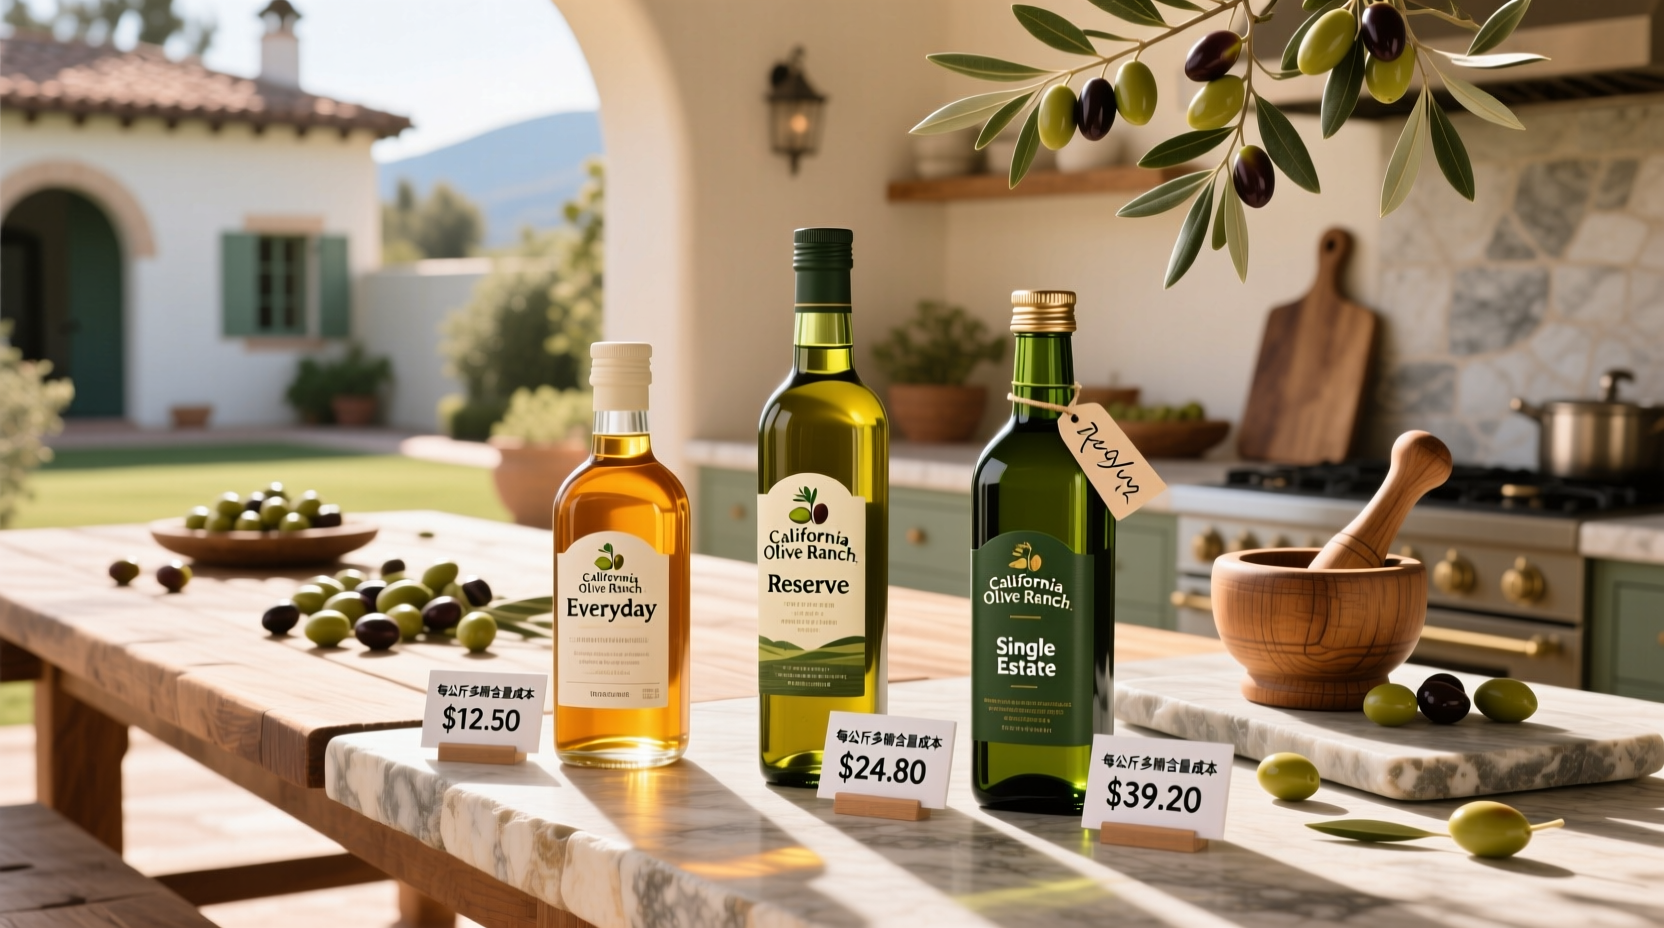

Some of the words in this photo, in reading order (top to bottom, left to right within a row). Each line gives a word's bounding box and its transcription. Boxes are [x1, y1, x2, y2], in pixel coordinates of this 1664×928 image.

[769, 527, 849, 547] California
[763, 544, 803, 560] Olive
[578, 583, 606, 593] Olive
[767, 573, 850, 595] Reserve
[989, 573, 1063, 594] California
[983, 590, 1021, 605] Olive
[566, 597, 658, 623] Everyday
[996, 636, 1056, 661] Single
[997, 656, 1057, 677] Estate
[442, 703, 521, 734] $12.50
[838, 750, 927, 785] $24.80
[1106, 775, 1202, 813] $39.20
